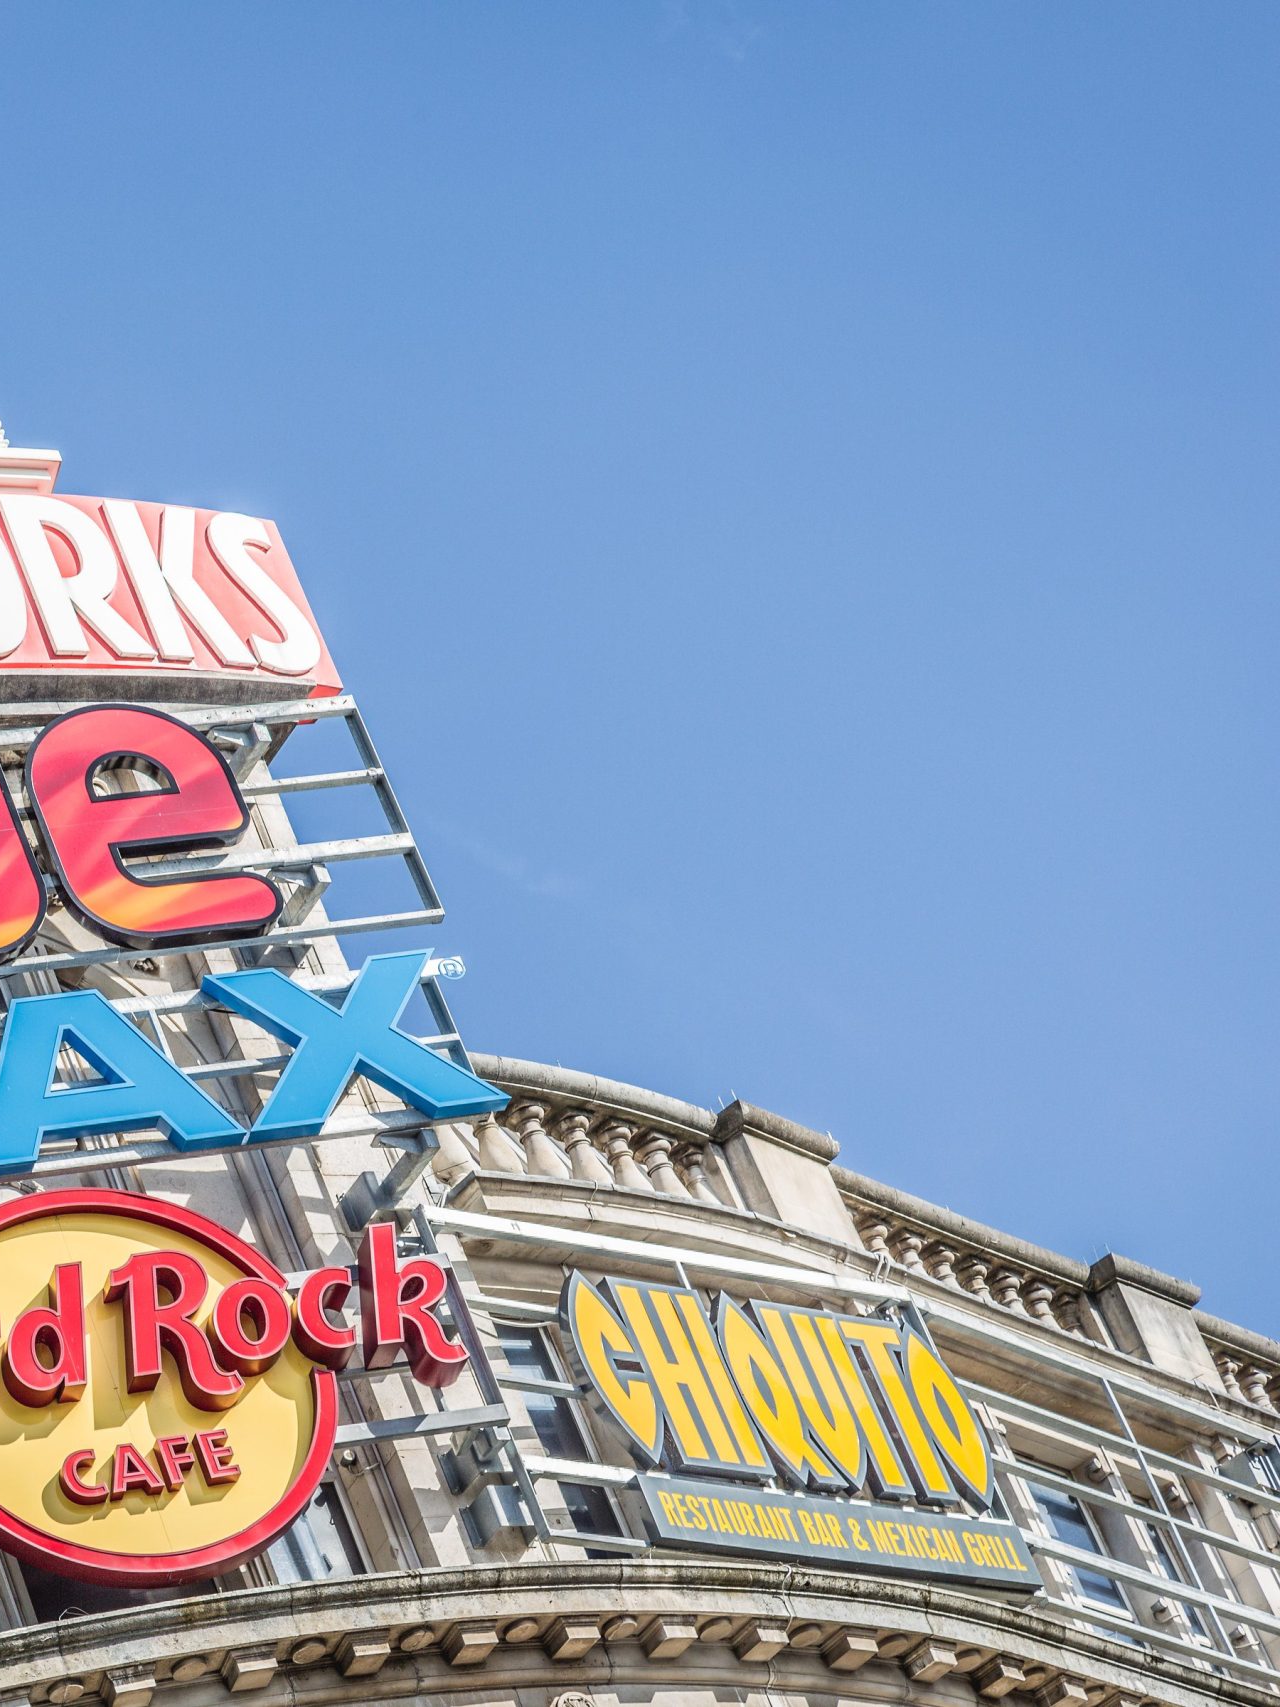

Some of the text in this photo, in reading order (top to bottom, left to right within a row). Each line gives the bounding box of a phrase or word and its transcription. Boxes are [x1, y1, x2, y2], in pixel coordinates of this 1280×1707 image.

[103, 1221, 470, 1408] Rock
[567, 1273, 993, 1506] CHIQUITO
[60, 1427, 243, 1504] CAFE
[657, 1490, 1028, 1572] RESTAURANT BAR & MEXICAN GRILL
